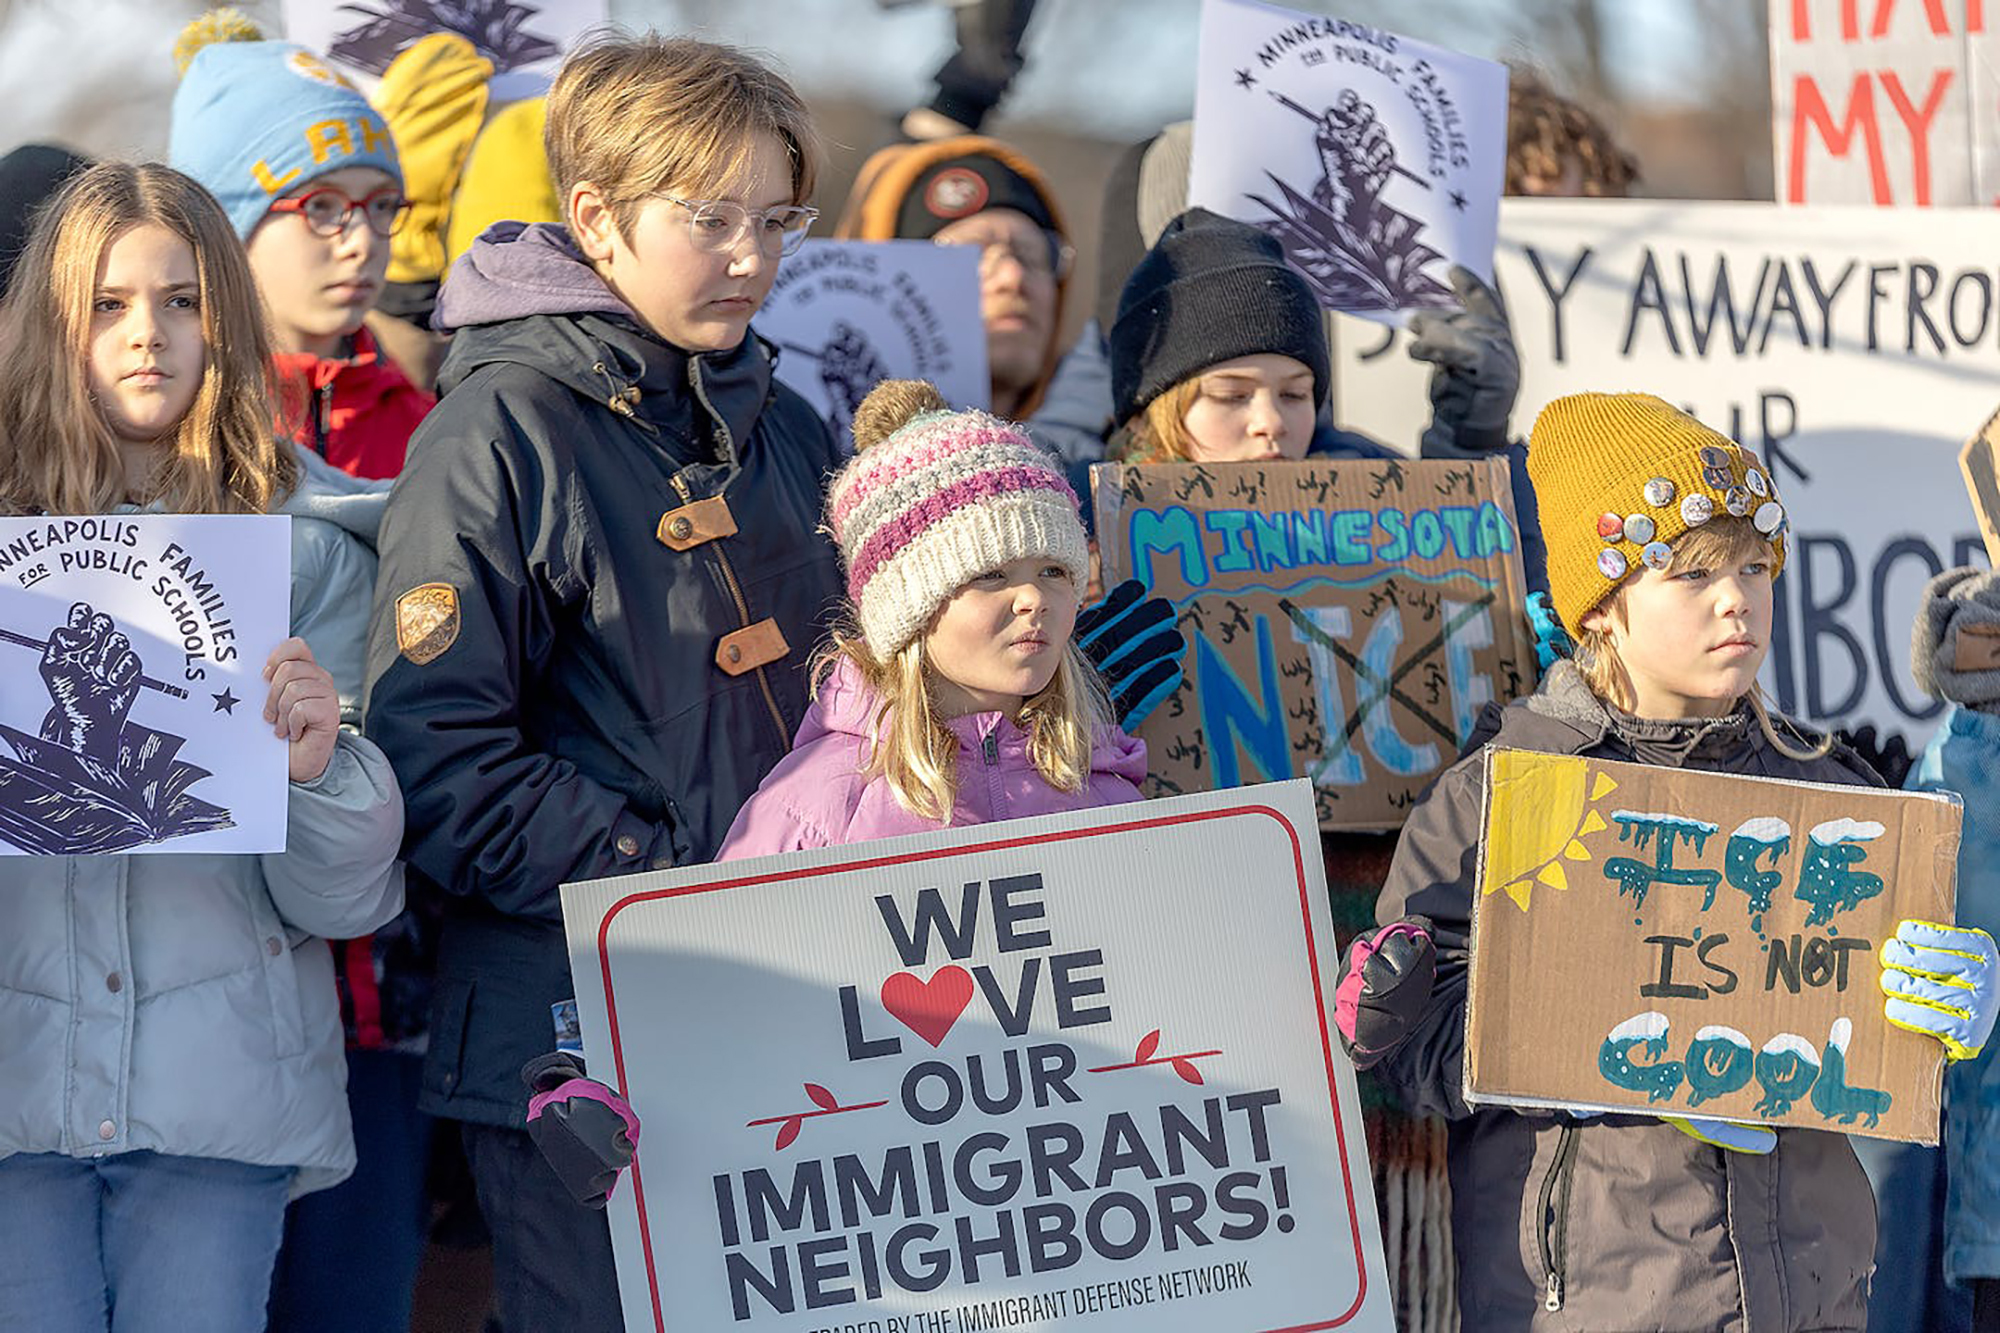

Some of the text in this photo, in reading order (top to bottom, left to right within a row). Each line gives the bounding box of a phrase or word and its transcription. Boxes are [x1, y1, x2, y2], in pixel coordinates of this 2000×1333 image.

[1256, 18, 1470, 170] MINNEAPOLIS FAMILIES
[1334, 44, 1404, 84] PUBLIC
[1405, 84, 1447, 179] SCHOOLS
[1789, 69, 1956, 206] MY
[1867, 262, 2000, 356] FRO
[159, 543, 237, 662] FAMILIES
[1130, 500, 1515, 592] MINNESOTA
[18, 549, 206, 681] FOR PUBLIC SCHOOLS
[875, 873, 1052, 967] WE
[1603, 810, 1886, 927] ICE
[1640, 933, 1872, 1000] IS NOT
[900, 1042, 1083, 1126] OUR
[1598, 1011, 1892, 1129] COOL
[712, 1088, 1282, 1247] IMMIGRANT
[724, 1165, 1296, 1321] NEIGHBORS!
[915, 1308, 952, 1333] THE
[957, 1290, 1068, 1333] IMMIGRANT
[1073, 1276, 1155, 1315] DEFENSE
[1158, 1260, 1252, 1302] NETWORK
